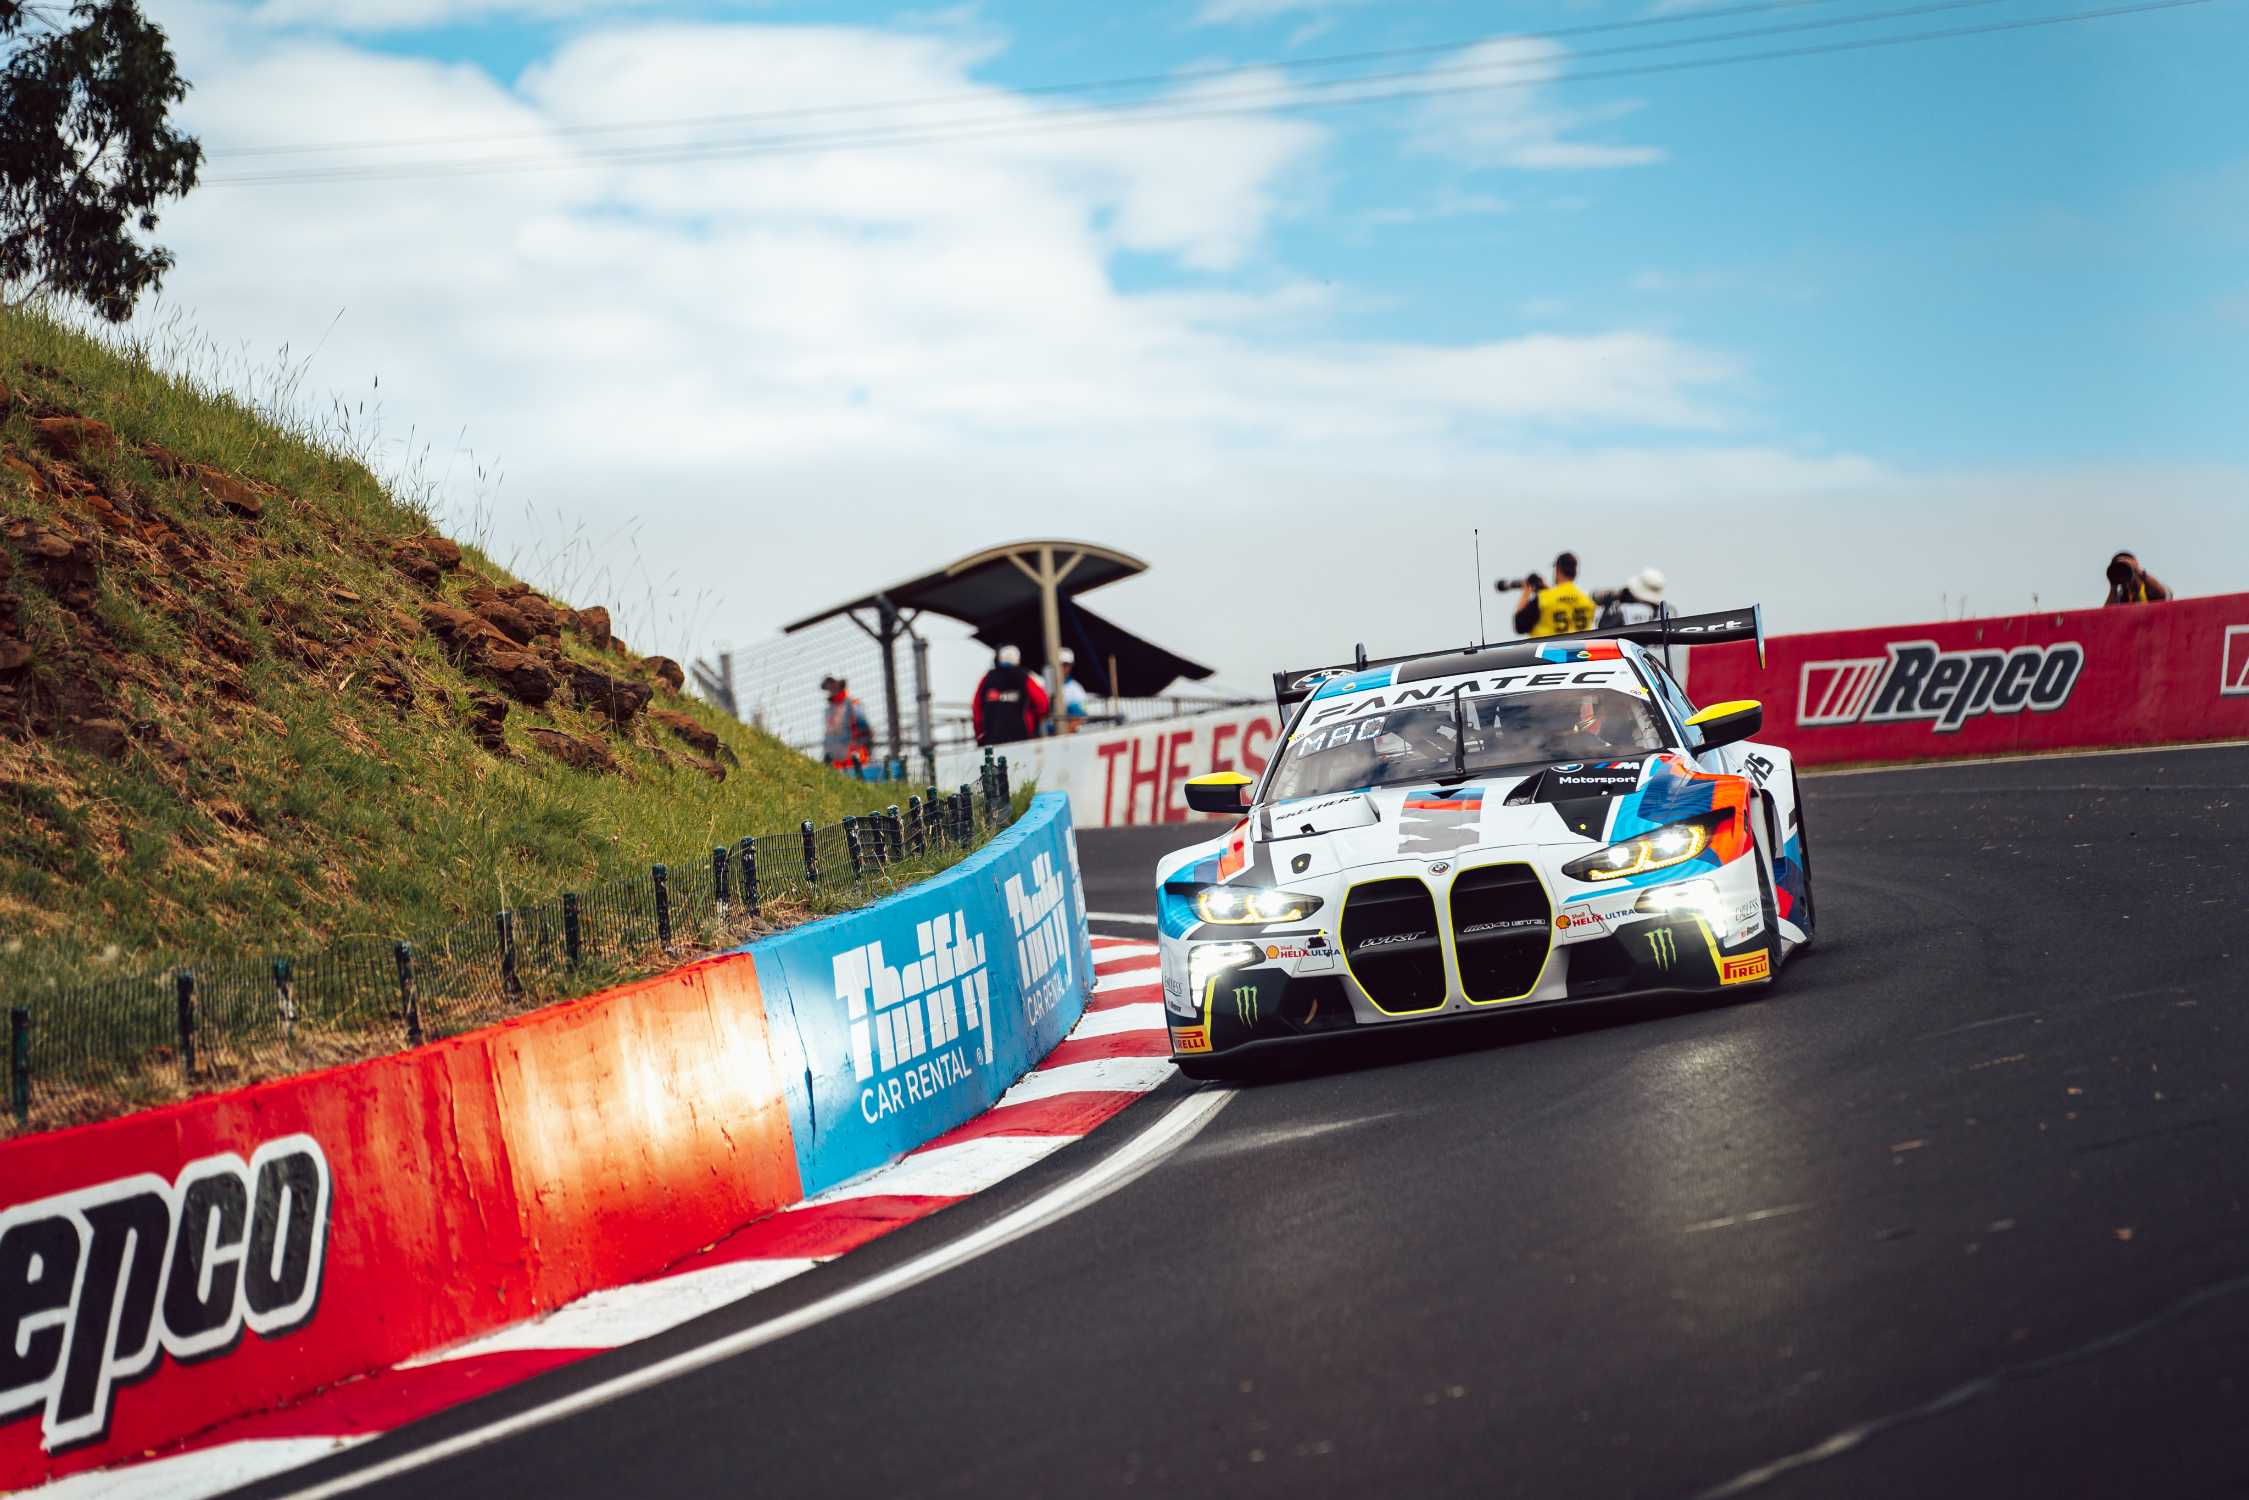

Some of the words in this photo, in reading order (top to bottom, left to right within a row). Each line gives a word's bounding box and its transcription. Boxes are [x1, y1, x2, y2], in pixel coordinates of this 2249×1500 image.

[1310, 670, 1616, 726] FANATEC
[1862, 639, 2084, 732] Repco
[1097, 730, 1194, 829] THE
[1559, 776, 1638, 785] Motorsport
[1275, 796, 1362, 821] SKECHERS
[1572, 914, 1605, 928] HELIX
[1604, 908, 1637, 920] ULTRA
[1280, 947, 1312, 958] HELIX
[1723, 954, 1767, 980] PIRELLI
[832, 909, 993, 1083] Thrifty
[1027, 991, 1045, 1027] CAR
[861, 1077, 905, 1125] CAR
[905, 1046, 973, 1105] RENTAL
[0, 1132, 334, 1456] epco
